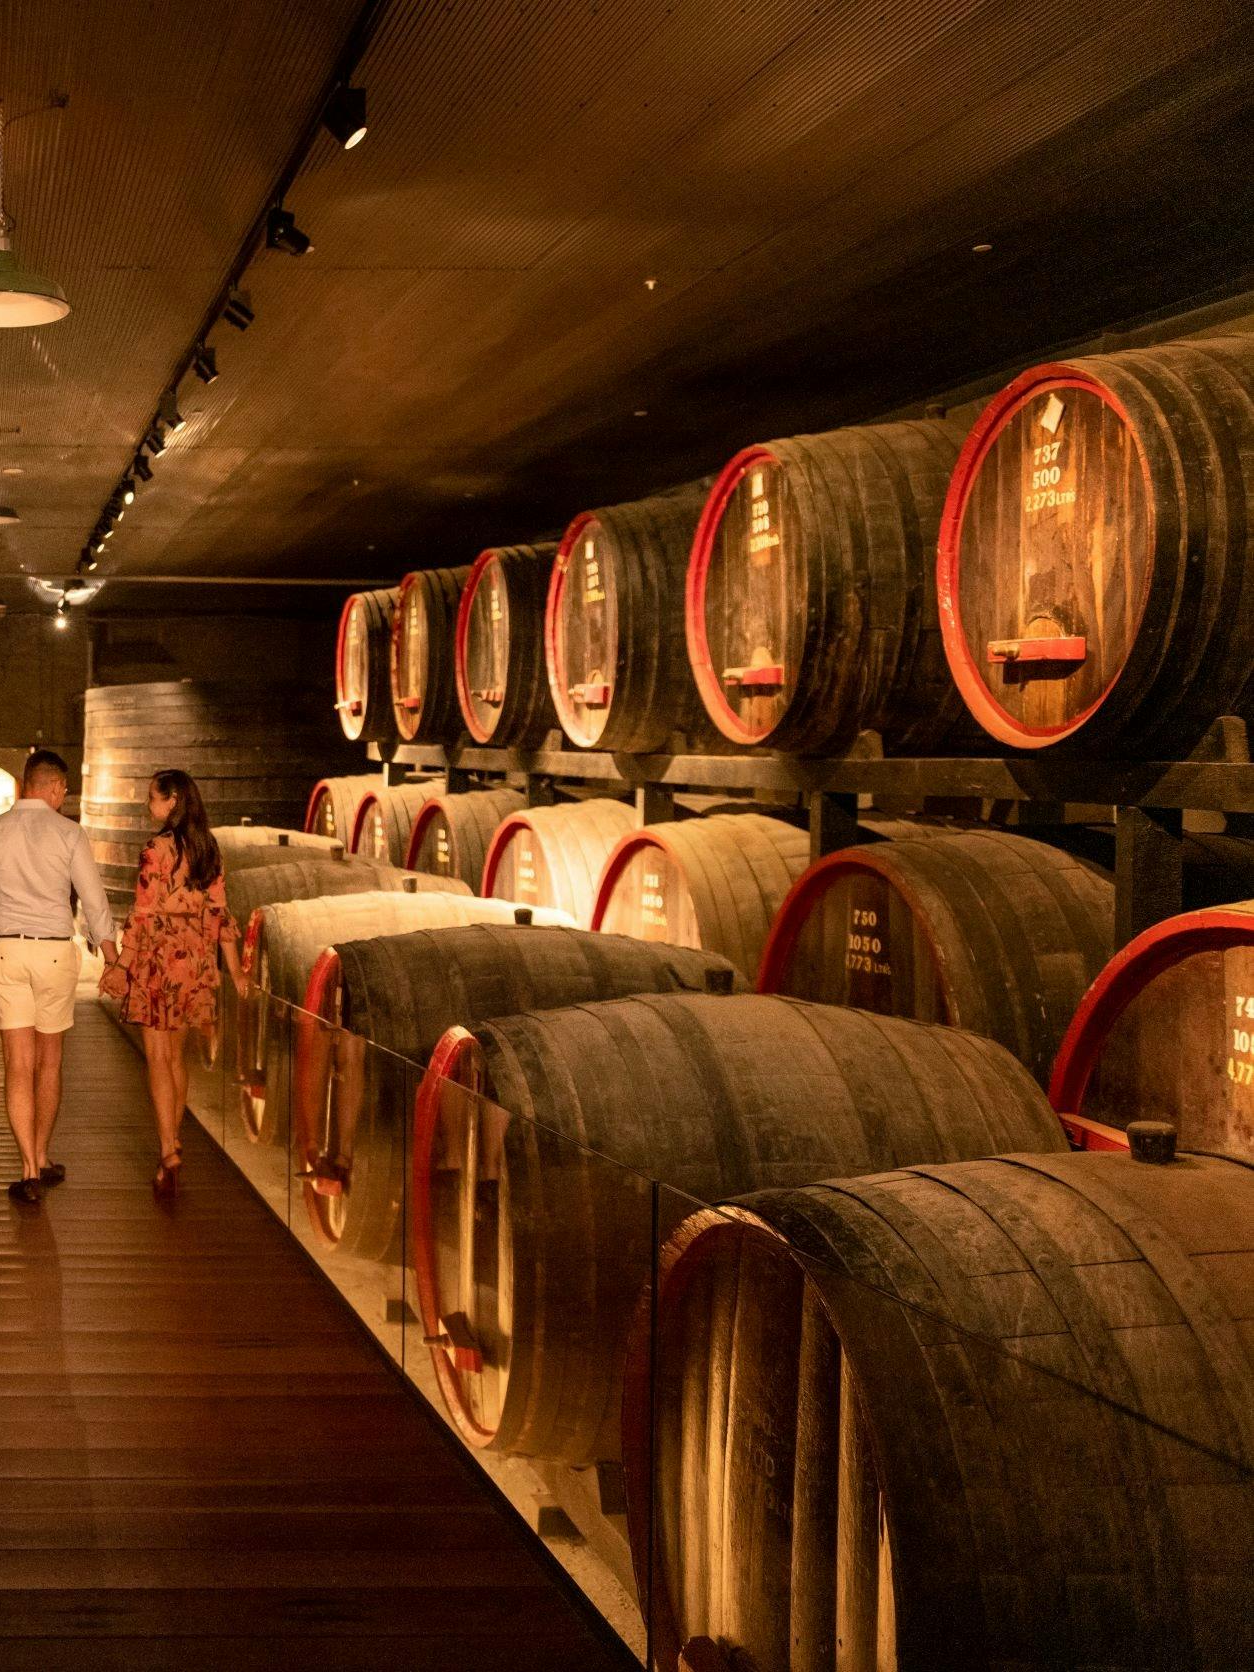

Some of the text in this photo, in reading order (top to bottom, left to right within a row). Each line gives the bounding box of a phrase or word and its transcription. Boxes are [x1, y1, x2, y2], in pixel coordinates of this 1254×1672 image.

[1034, 442, 1061, 466] 737
[1033, 467, 1060, 489] 500
[854, 909, 877, 926] 750
[848, 933, 881, 954] 1050
